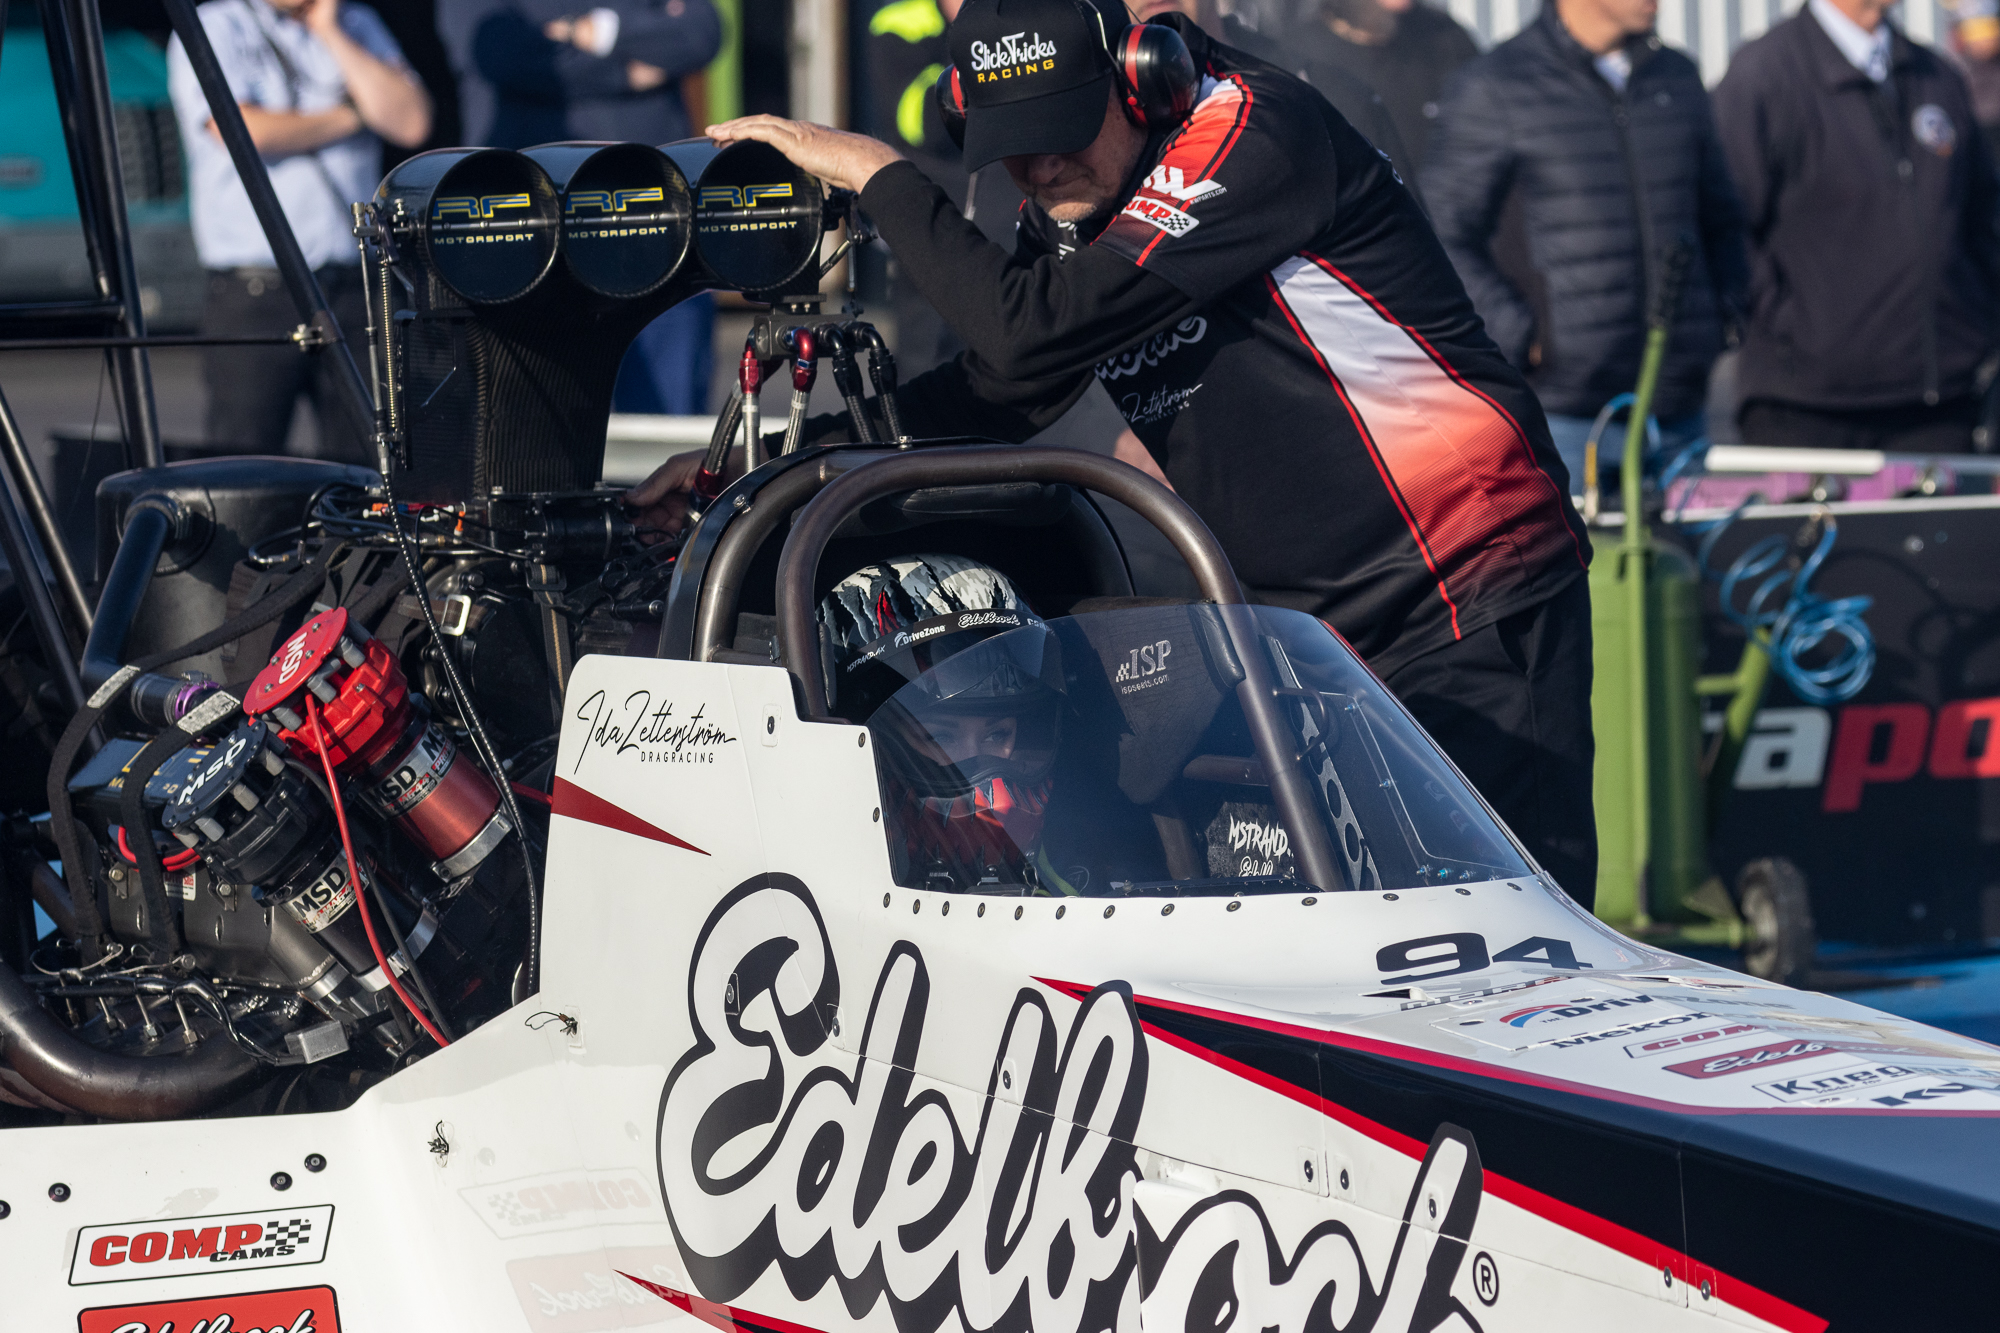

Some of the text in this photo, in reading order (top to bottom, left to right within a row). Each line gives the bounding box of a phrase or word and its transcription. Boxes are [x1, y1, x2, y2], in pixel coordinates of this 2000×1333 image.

[977, 59, 1055, 83] RACING
[432, 192, 531, 220] RF
[565, 186, 664, 214] RF
[434, 232, 535, 246] MOTORSPORT
[568, 226, 668, 240] MOTORSPORT
[699, 220, 798, 234] MOTORSPORT
[902, 624, 946, 646] DriveZone
[957, 611, 1021, 629] Edelbrock
[278, 631, 308, 685] MSD
[1129, 639, 1172, 680] ISP
[1120, 674, 1170, 695] ispseats.com
[573, 689, 737, 775] Ida Zetterström
[178, 738, 247, 806] MSD
[640, 751, 714, 764] DRAGRACING
[1703, 696, 2000, 813] apo
[292, 866, 346, 918] MSD
[1375, 931, 1594, 986] 94
[655, 871, 1488, 1333] Edelbock
[89, 1223, 263, 1267] COMP
[208, 1244, 296, 1263] CAMS
